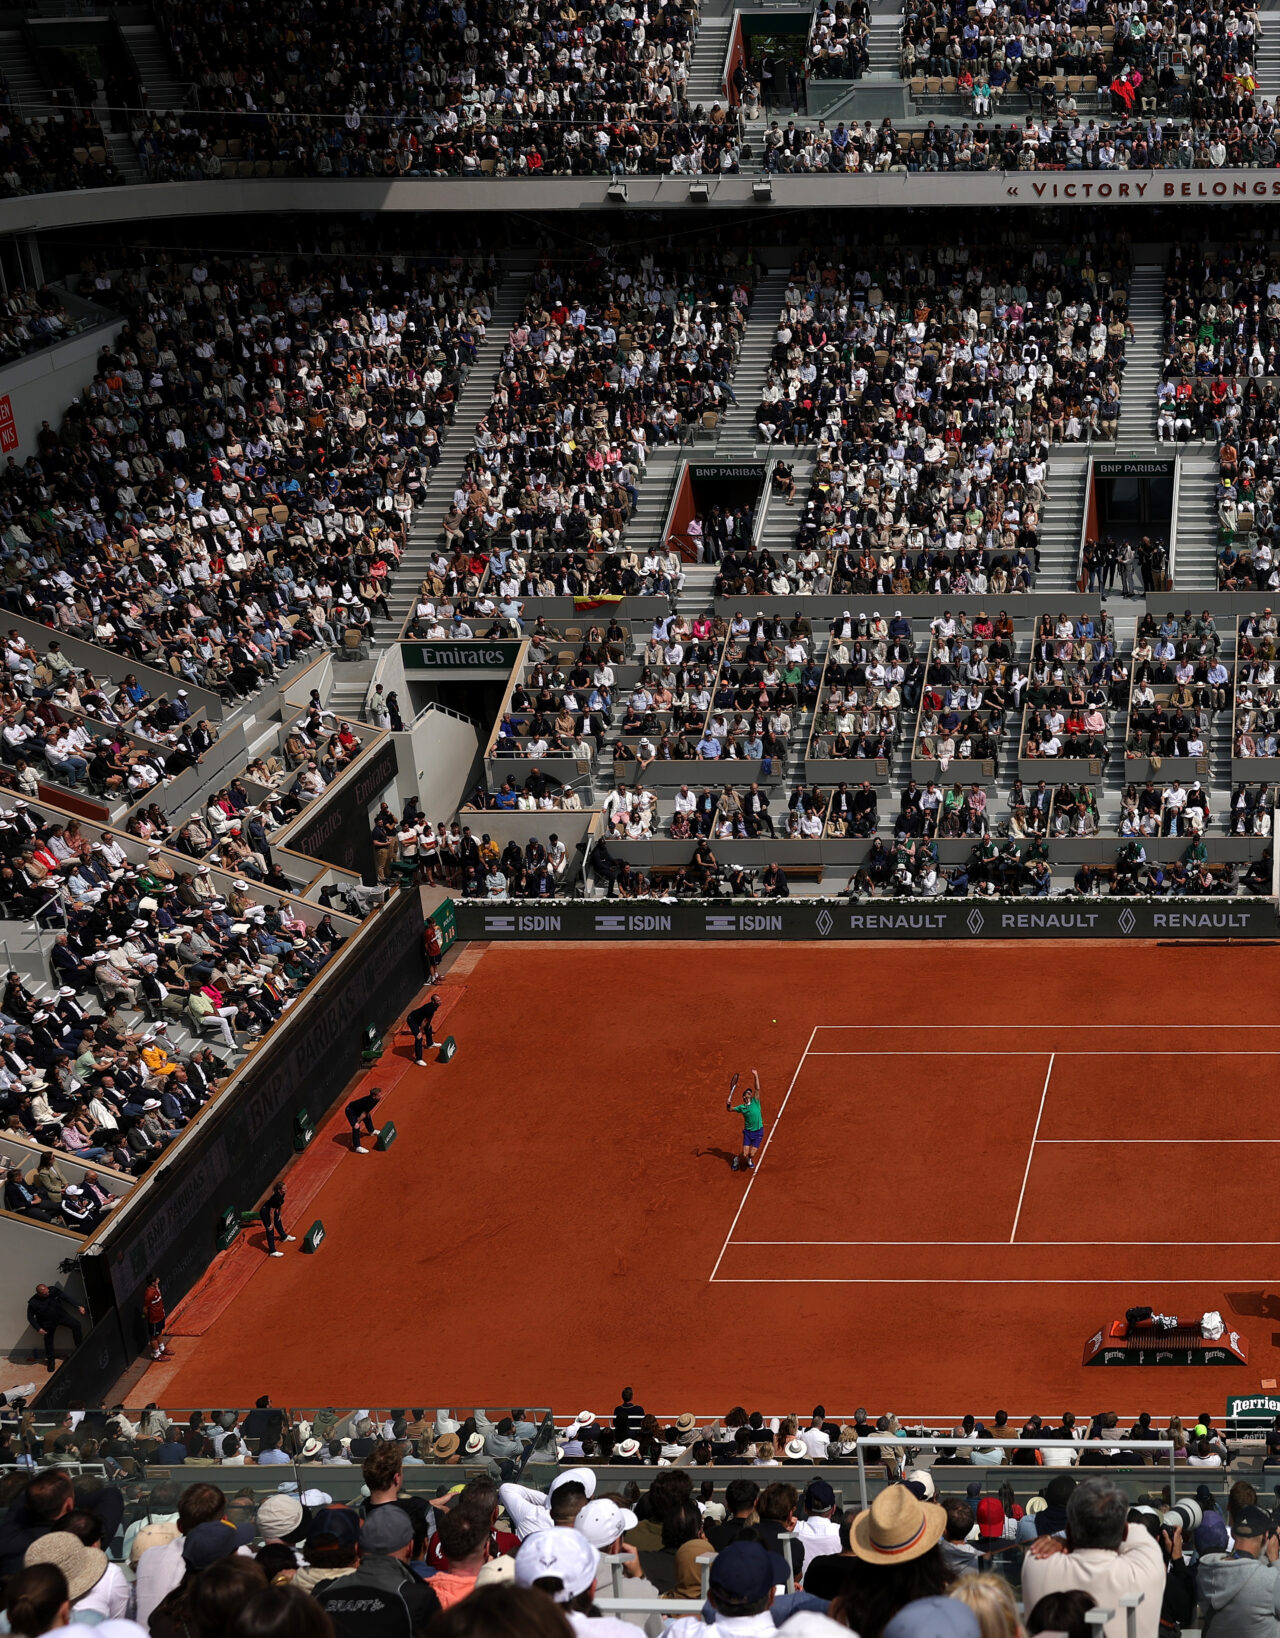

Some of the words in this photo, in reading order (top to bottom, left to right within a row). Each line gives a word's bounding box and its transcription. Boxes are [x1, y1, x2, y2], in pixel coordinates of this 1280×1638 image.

[1033, 182, 1149, 198] VICTORY
[696, 468, 718, 476] BNP
[720, 468, 762, 476] PARIBAS
[1100, 464, 1121, 472] BNP
[1124, 464, 1168, 472] PARIBAS
[421, 646, 504, 665] Emirates
[354, 759, 392, 806] Emirates
[300, 808, 342, 855] Emirates
[518, 915, 560, 930] ISDIN
[628, 915, 671, 930] ISDIN
[739, 915, 782, 930] ISDIN
[850, 914, 947, 928] RENAULT
[1002, 914, 1099, 928] RENAULT
[1153, 913, 1251, 927] RENAULT
